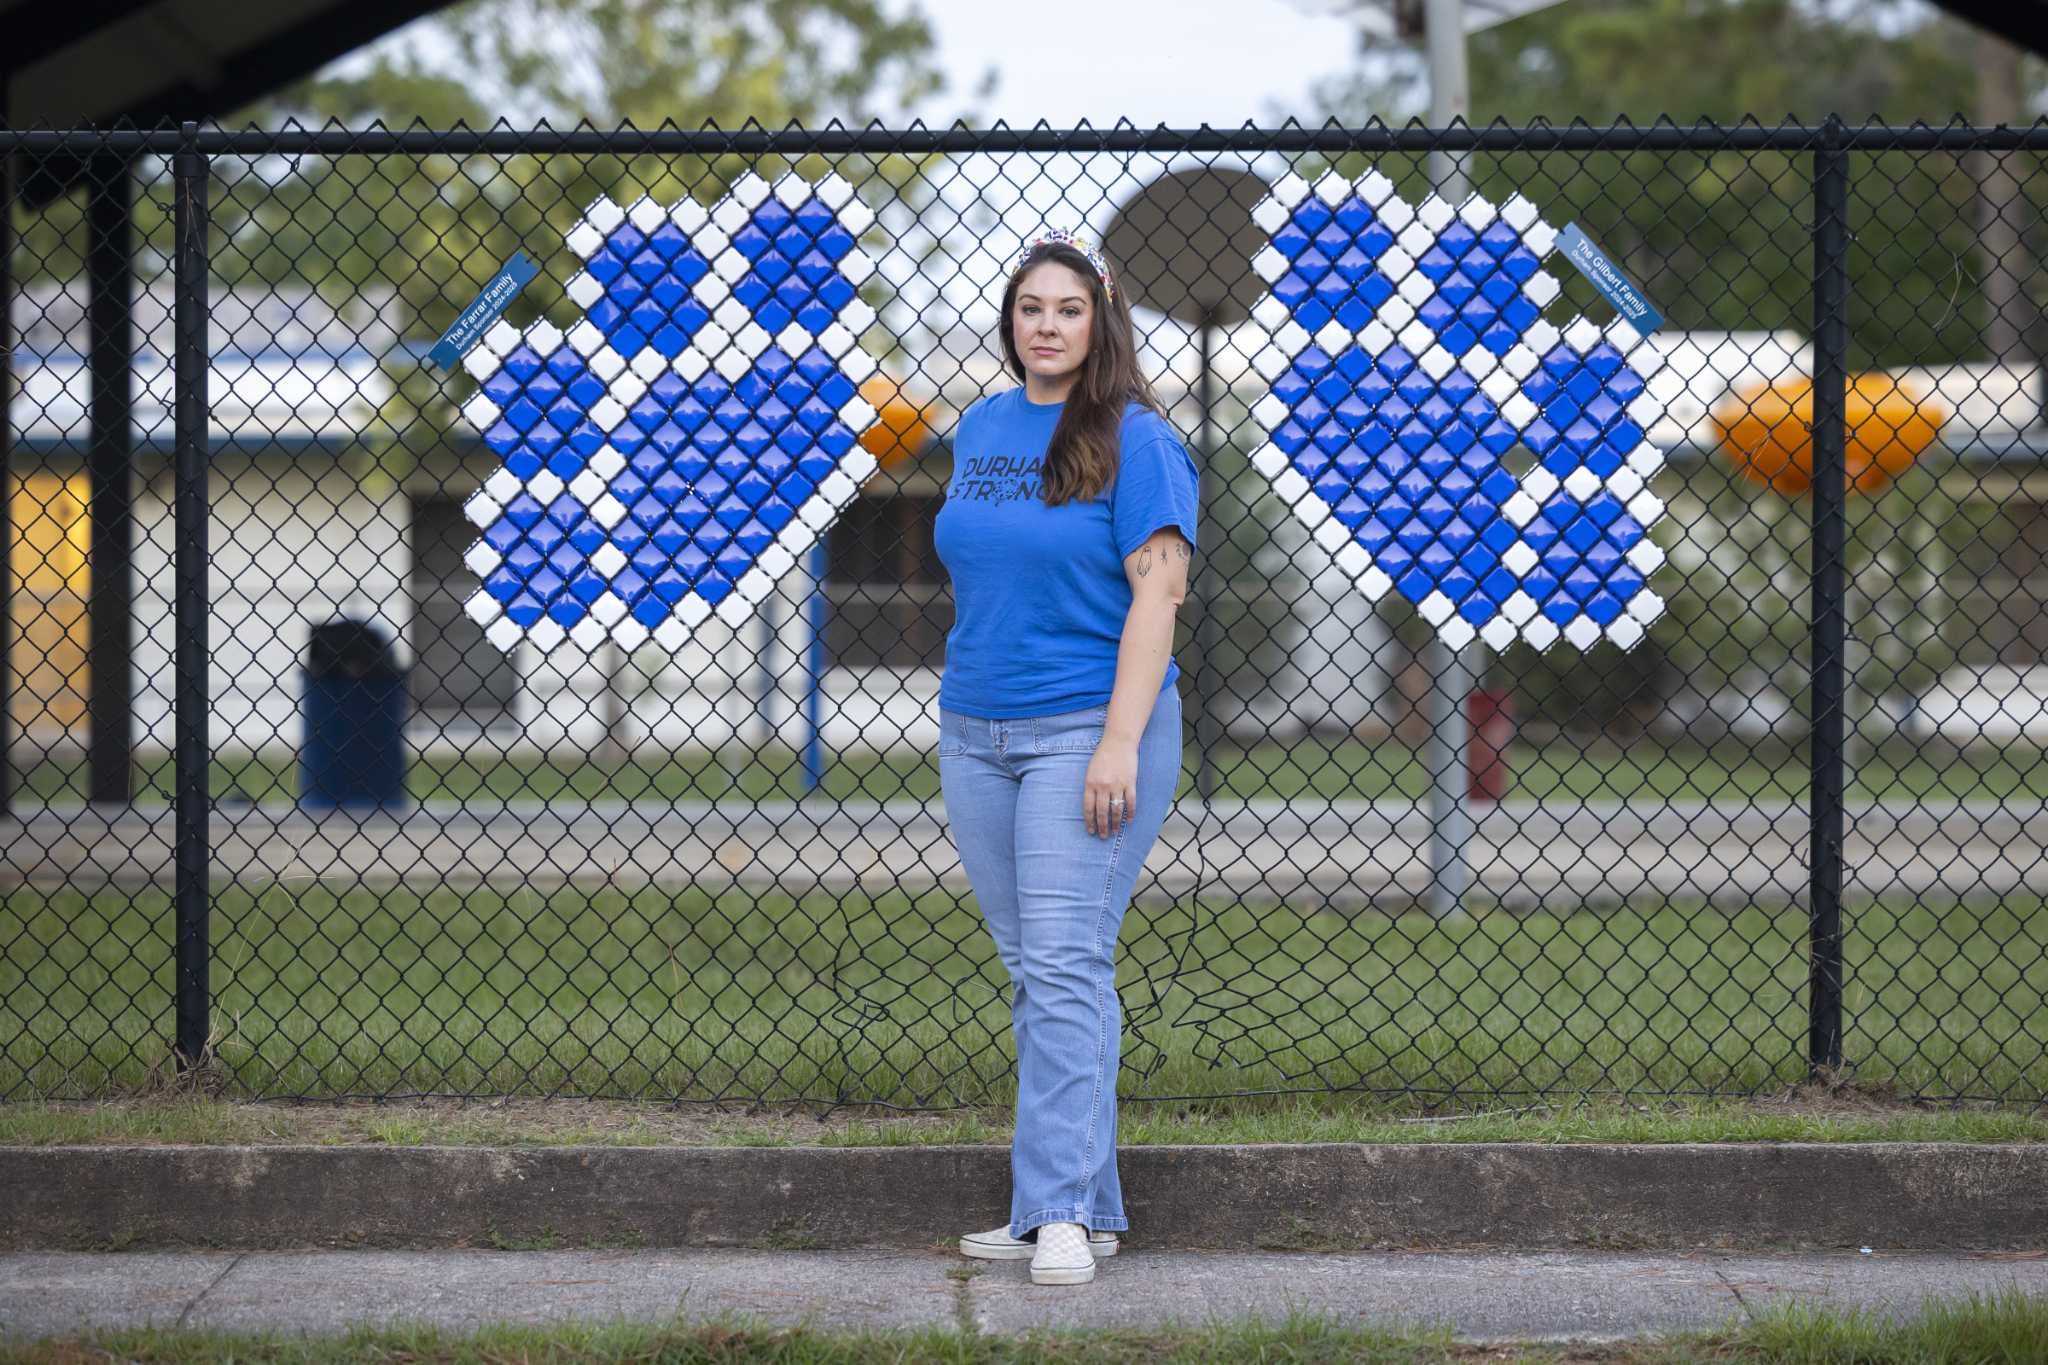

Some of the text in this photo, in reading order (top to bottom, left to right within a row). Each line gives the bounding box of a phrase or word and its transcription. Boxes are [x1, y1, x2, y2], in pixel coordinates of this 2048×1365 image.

[1577, 238, 1648, 316] The Gilbert Family
[445, 273, 514, 345] The Farrar Family
[455, 328, 475, 351] Durham
[962, 455, 1047, 479] DURHA
